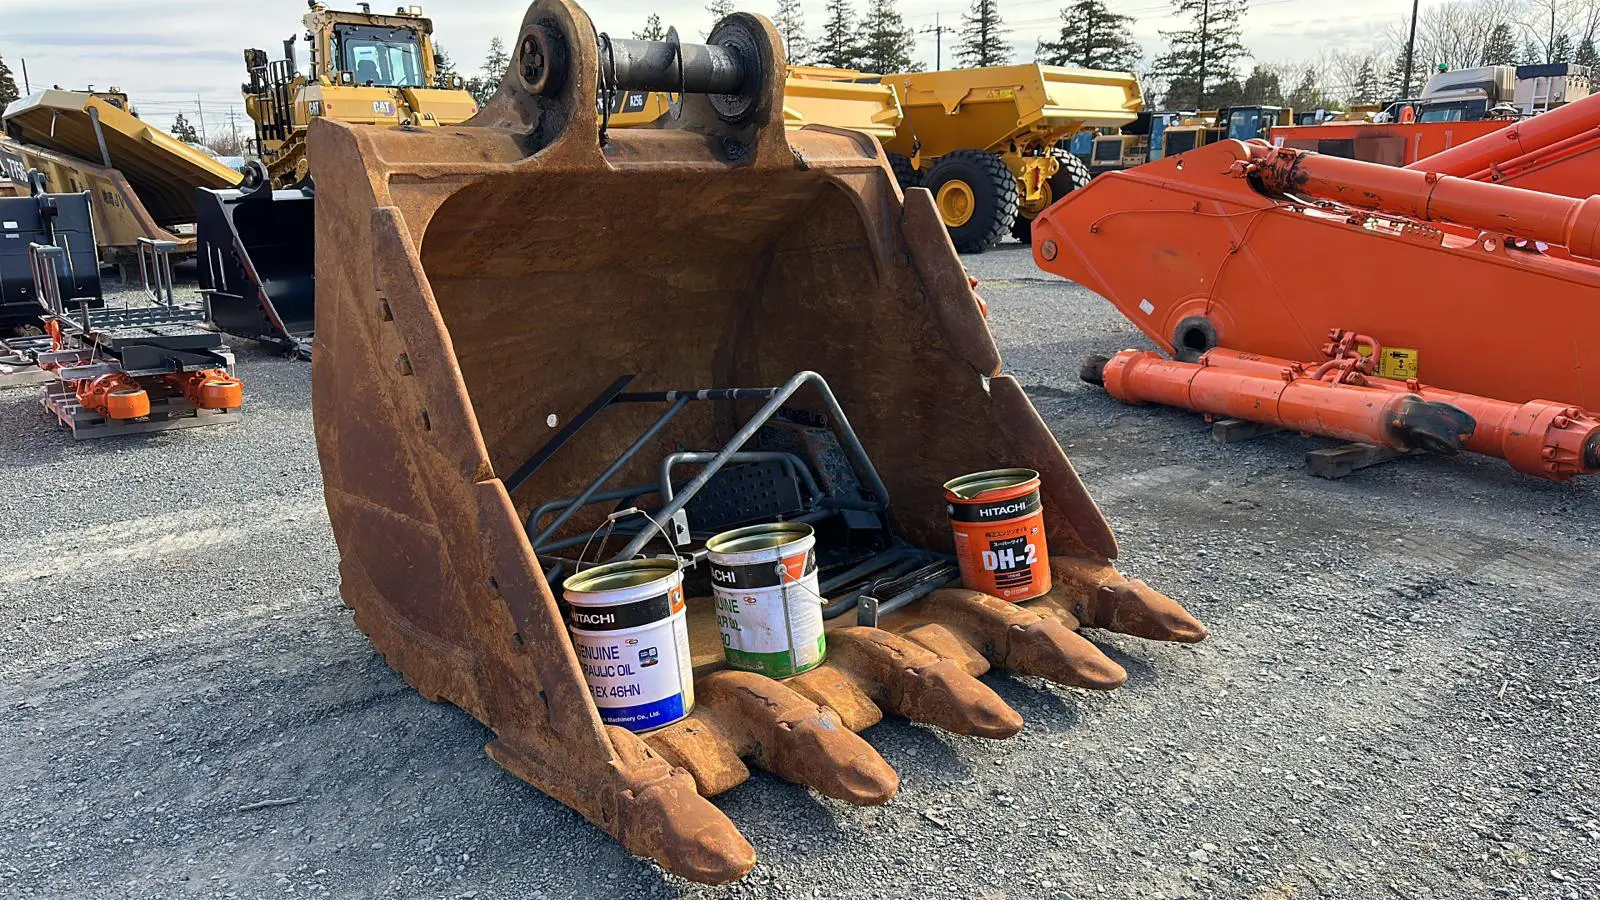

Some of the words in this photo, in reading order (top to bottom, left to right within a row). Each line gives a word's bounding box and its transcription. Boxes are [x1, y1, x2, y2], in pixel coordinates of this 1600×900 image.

[308, 101, 319, 116] CAT
[373, 101, 390, 113] CAT
[979, 501, 1026, 517] HITACHI
[981, 543, 1038, 571] DH-2
[571, 611, 615, 624] HITACHI
[576, 644, 620, 660] GENUINE
[617, 663, 636, 677] OIL
[596, 686, 608, 698] EX
[610, 683, 641, 698] 46HN
